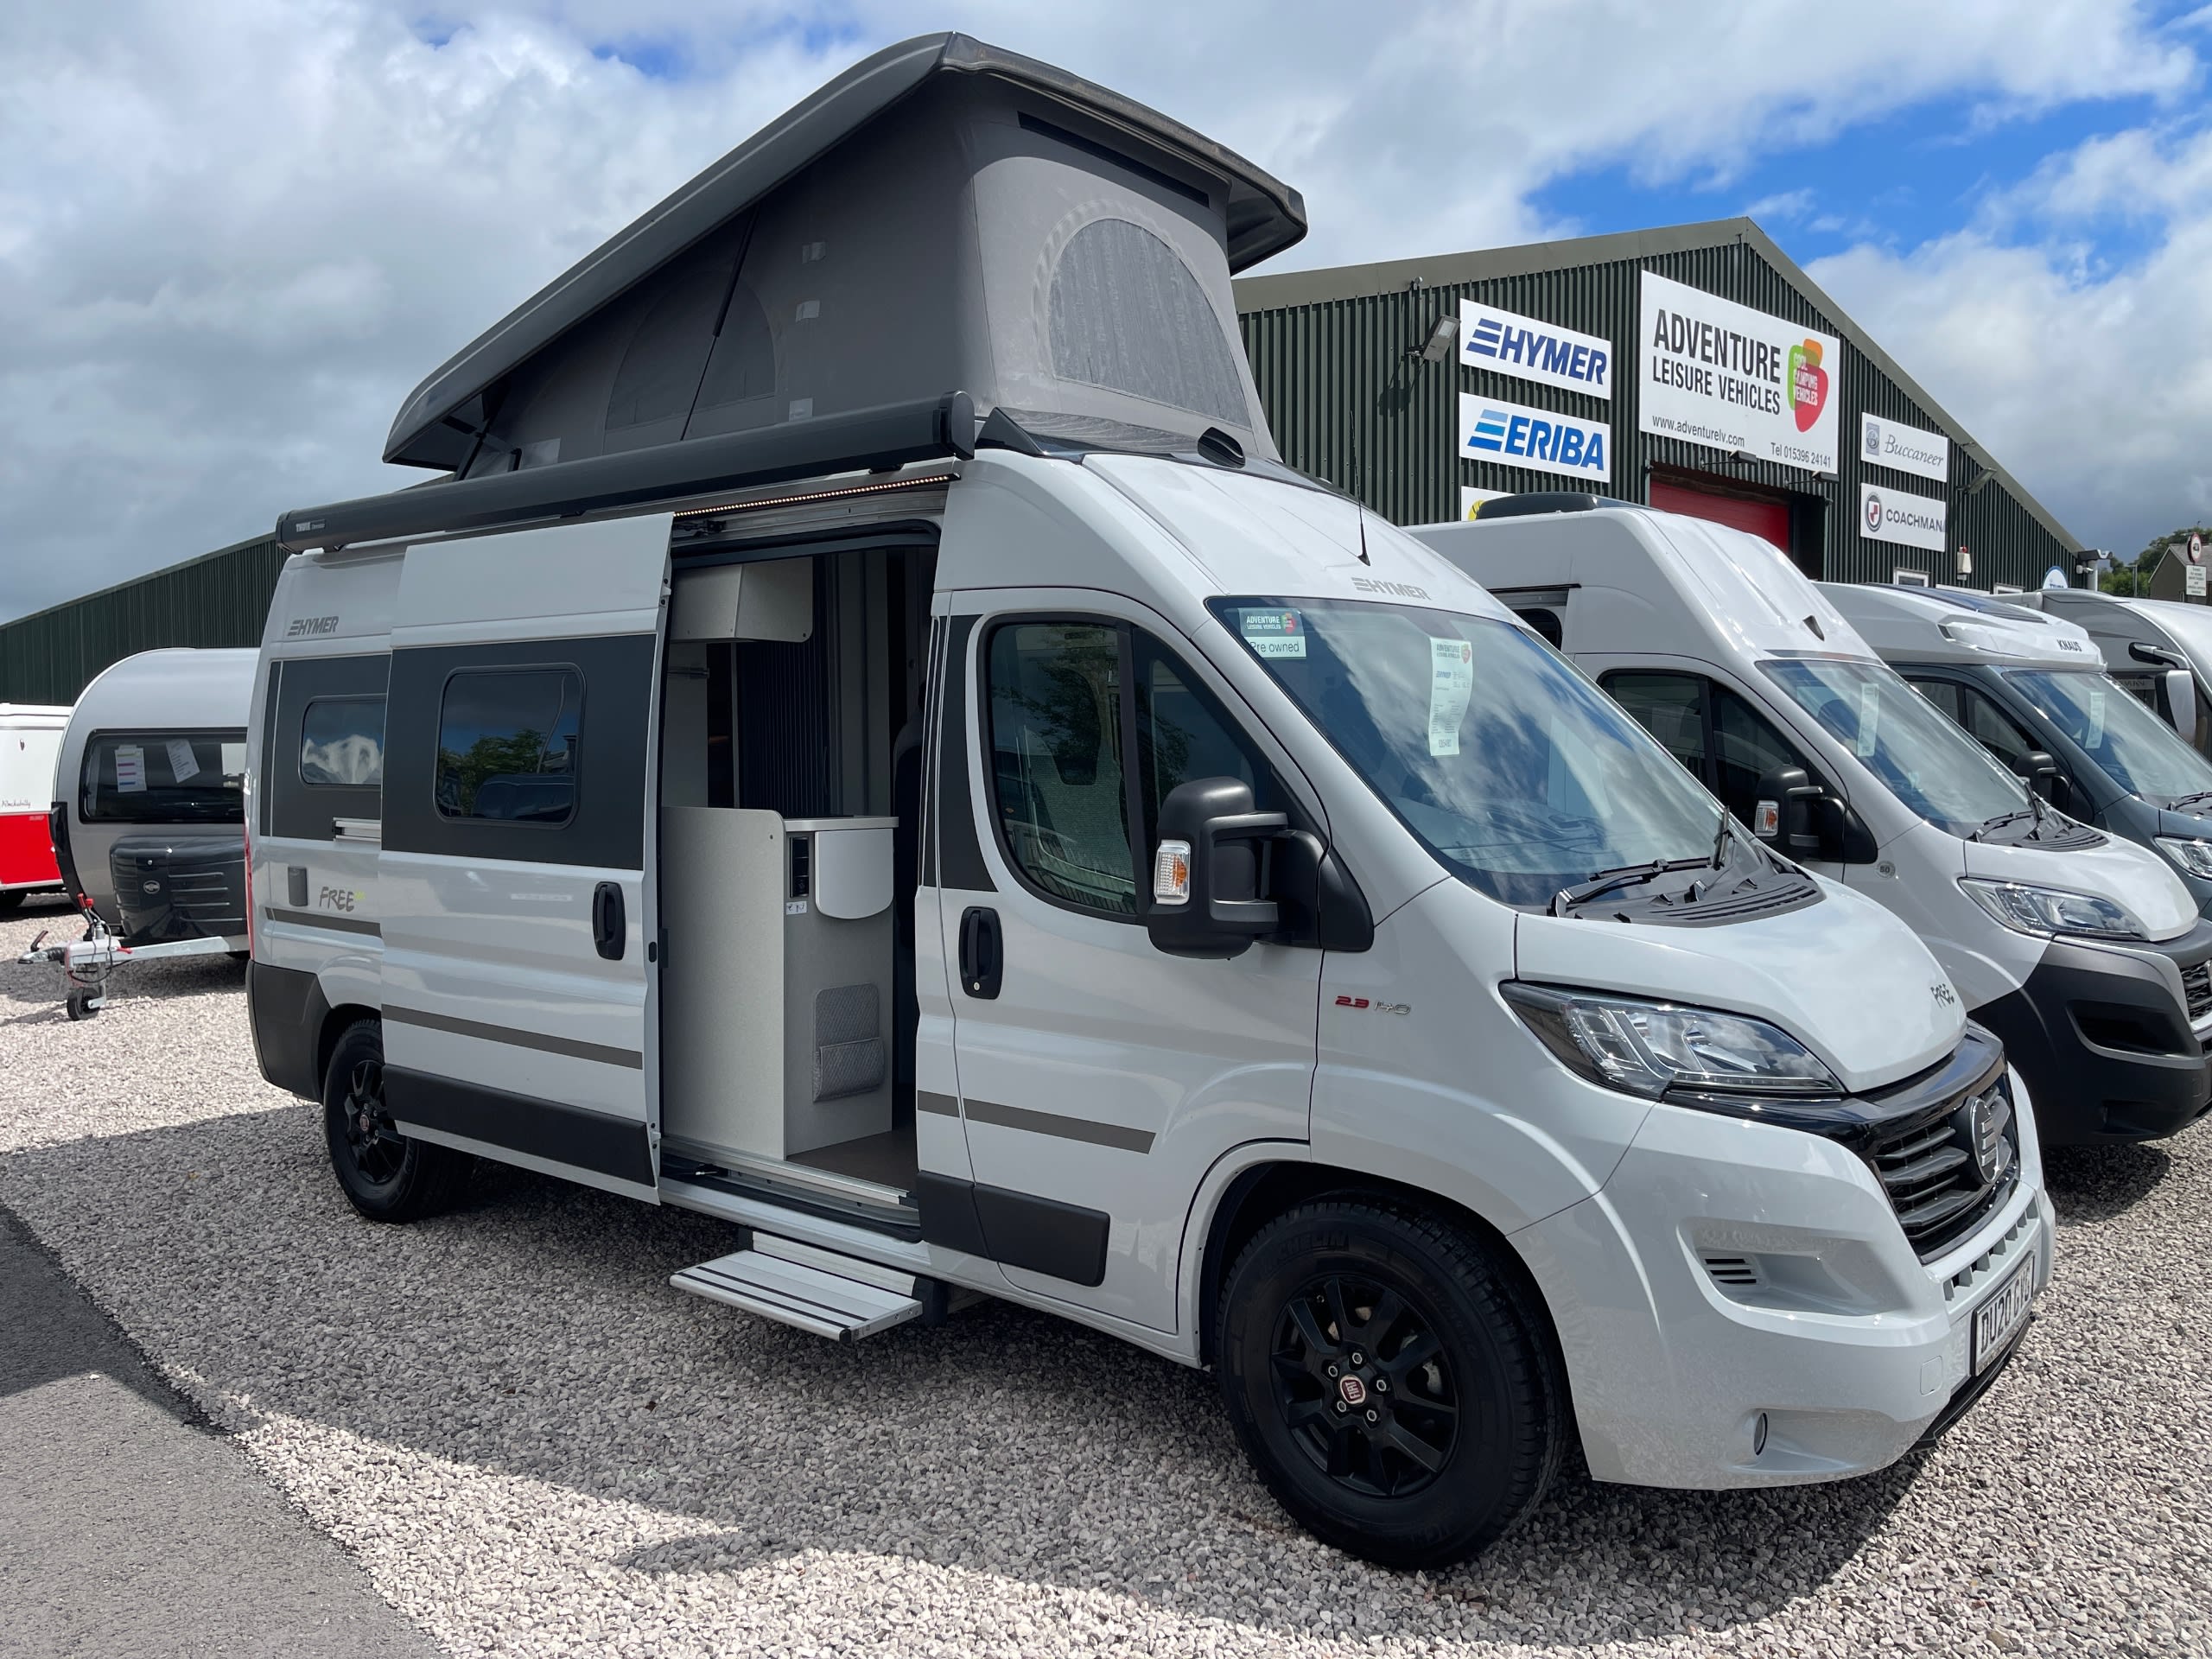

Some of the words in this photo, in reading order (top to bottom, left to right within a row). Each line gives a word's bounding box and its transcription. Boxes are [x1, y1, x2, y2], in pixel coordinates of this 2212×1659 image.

[1498, 325, 1607, 385] HYMER
[1653, 308, 1781, 384] ADVENTURE
[1653, 355, 1713, 397] LEISURE
[1718, 374, 1780, 415] VEHICLES
[1504, 415, 1605, 471] ERIBA
[1652, 415, 1745, 448] www.adventurelv.com
[1770, 442, 1783, 456] Tel
[1783, 446, 1809, 463] 015396
[1811, 451, 1831, 468] 24141
[1885, 434, 1943, 467] Buccaneer
[1885, 508, 1942, 533] COACHMAN
[1364, 579, 1432, 601] HYMER
[297, 615, 339, 636] HYMER
[1246, 615, 1281, 624] ADVENTURE
[1268, 641, 1300, 653] owned
[2056, 639, 2082, 652] KNAUS
[319, 886, 354, 913] FREE
[1335, 995, 1370, 1008] 2.3
[1374, 1001, 1411, 1015] 140
[1930, 983, 1955, 1009] FREE
[1980, 1288, 2012, 1354] DU20
[1344, 1381, 1362, 1400] FIAT
